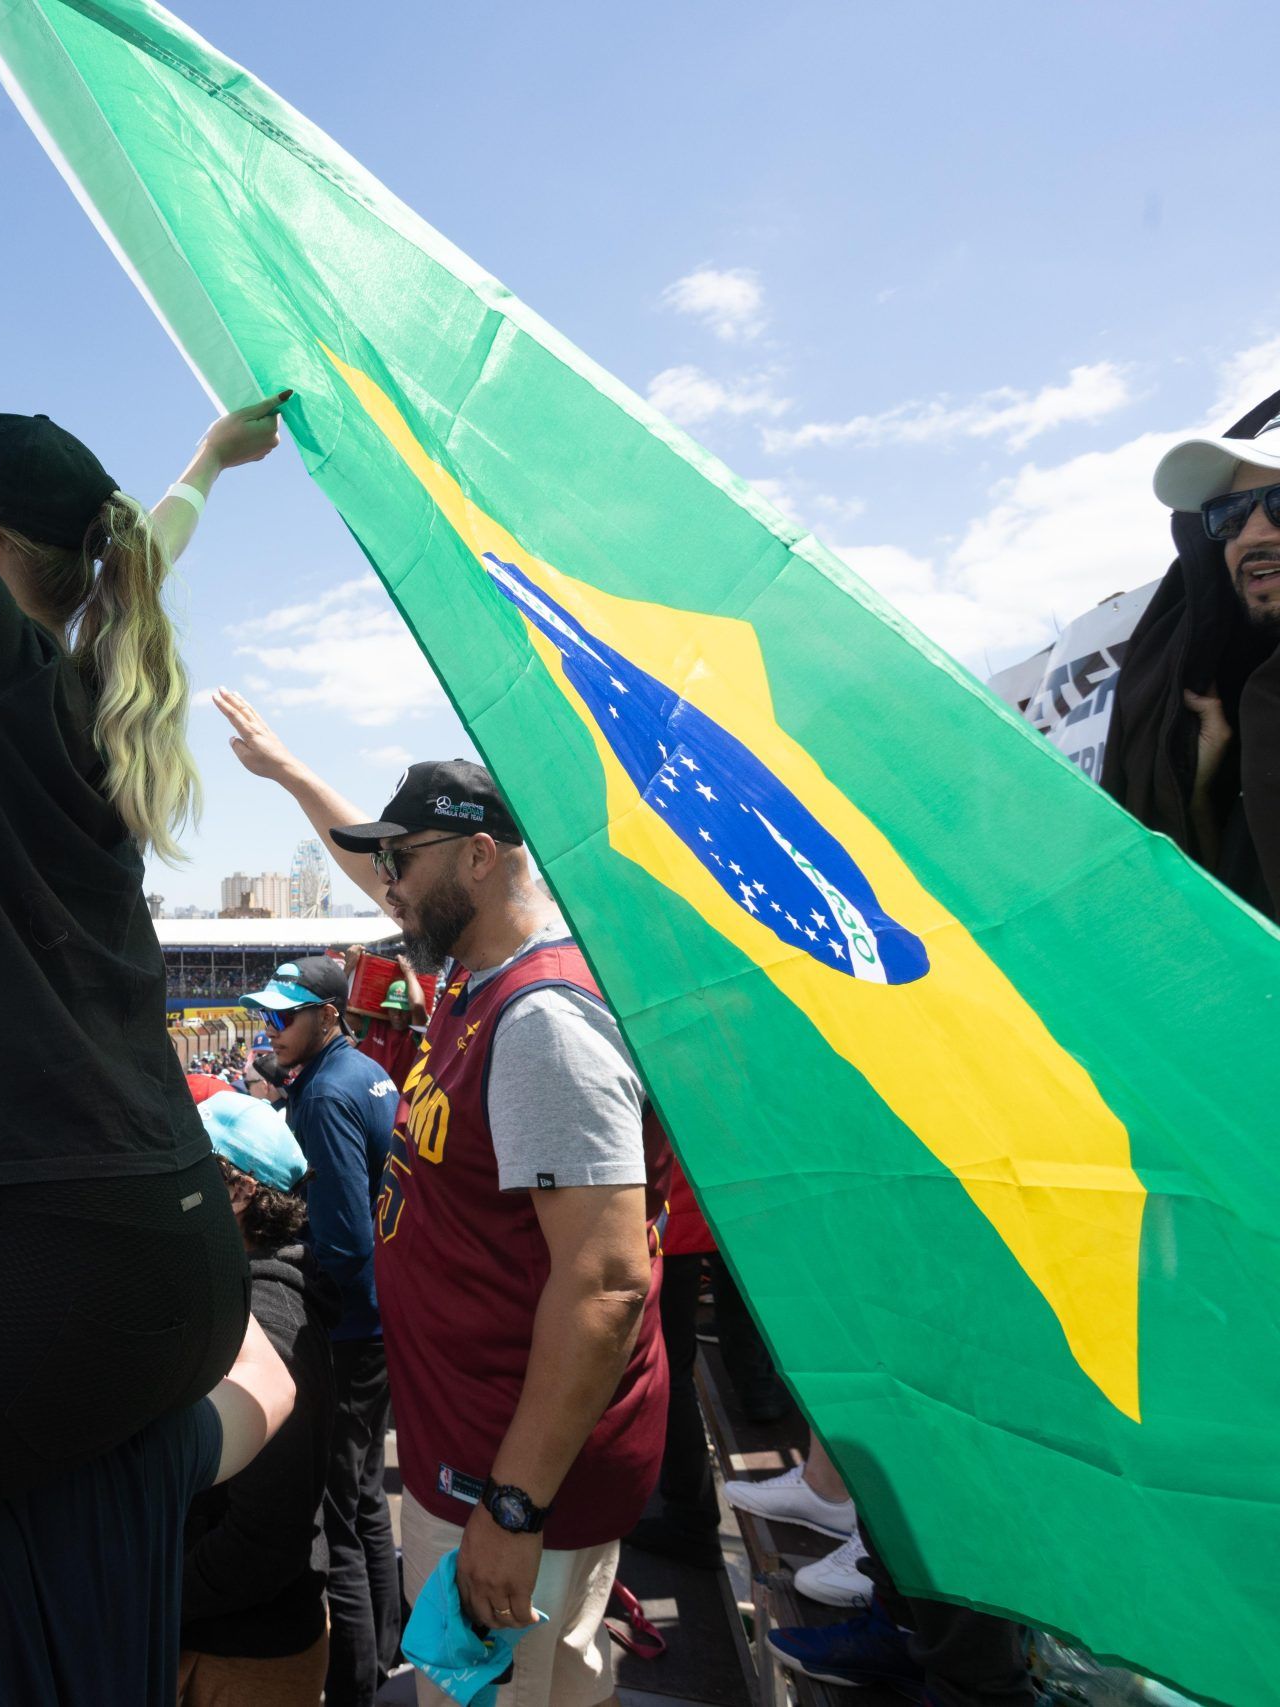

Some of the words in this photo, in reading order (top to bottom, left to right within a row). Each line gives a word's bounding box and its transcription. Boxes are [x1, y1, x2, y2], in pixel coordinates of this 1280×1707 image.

[434, 808, 458, 817] FORMULA
[470, 814, 484, 822] TEAM
[450, 804, 484, 817] PETRONAS
